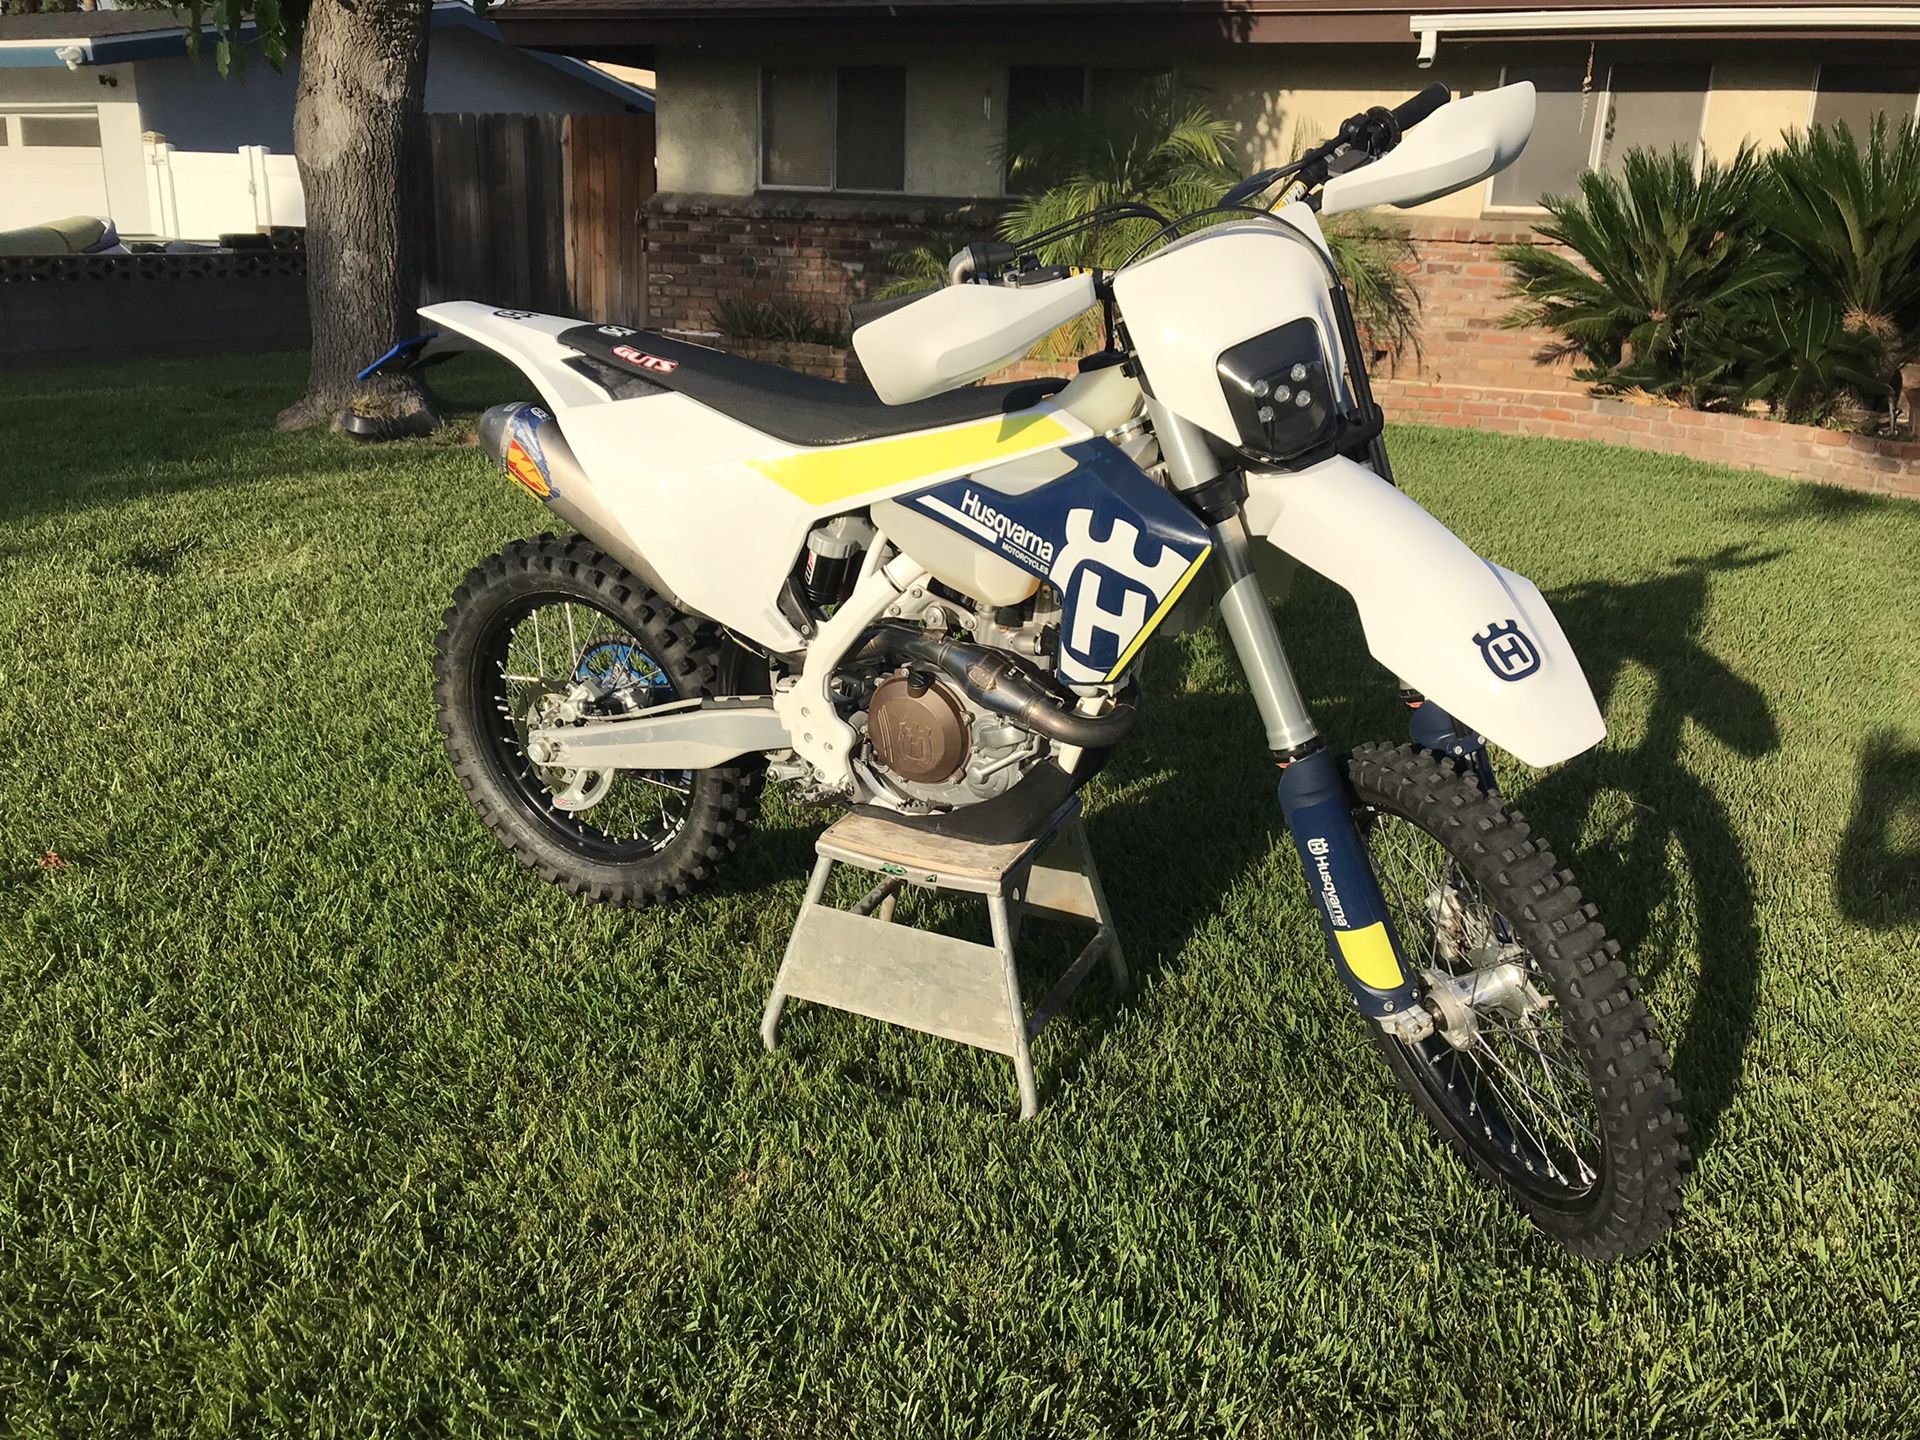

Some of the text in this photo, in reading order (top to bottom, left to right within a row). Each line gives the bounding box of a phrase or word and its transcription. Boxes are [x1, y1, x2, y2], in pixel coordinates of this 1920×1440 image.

[613, 345, 679, 373] GUTS
[961, 489, 1054, 562] Husqvarna
[1001, 542, 1049, 575] MOTORCYCLES
[1314, 855, 1348, 927] Husqvarna
